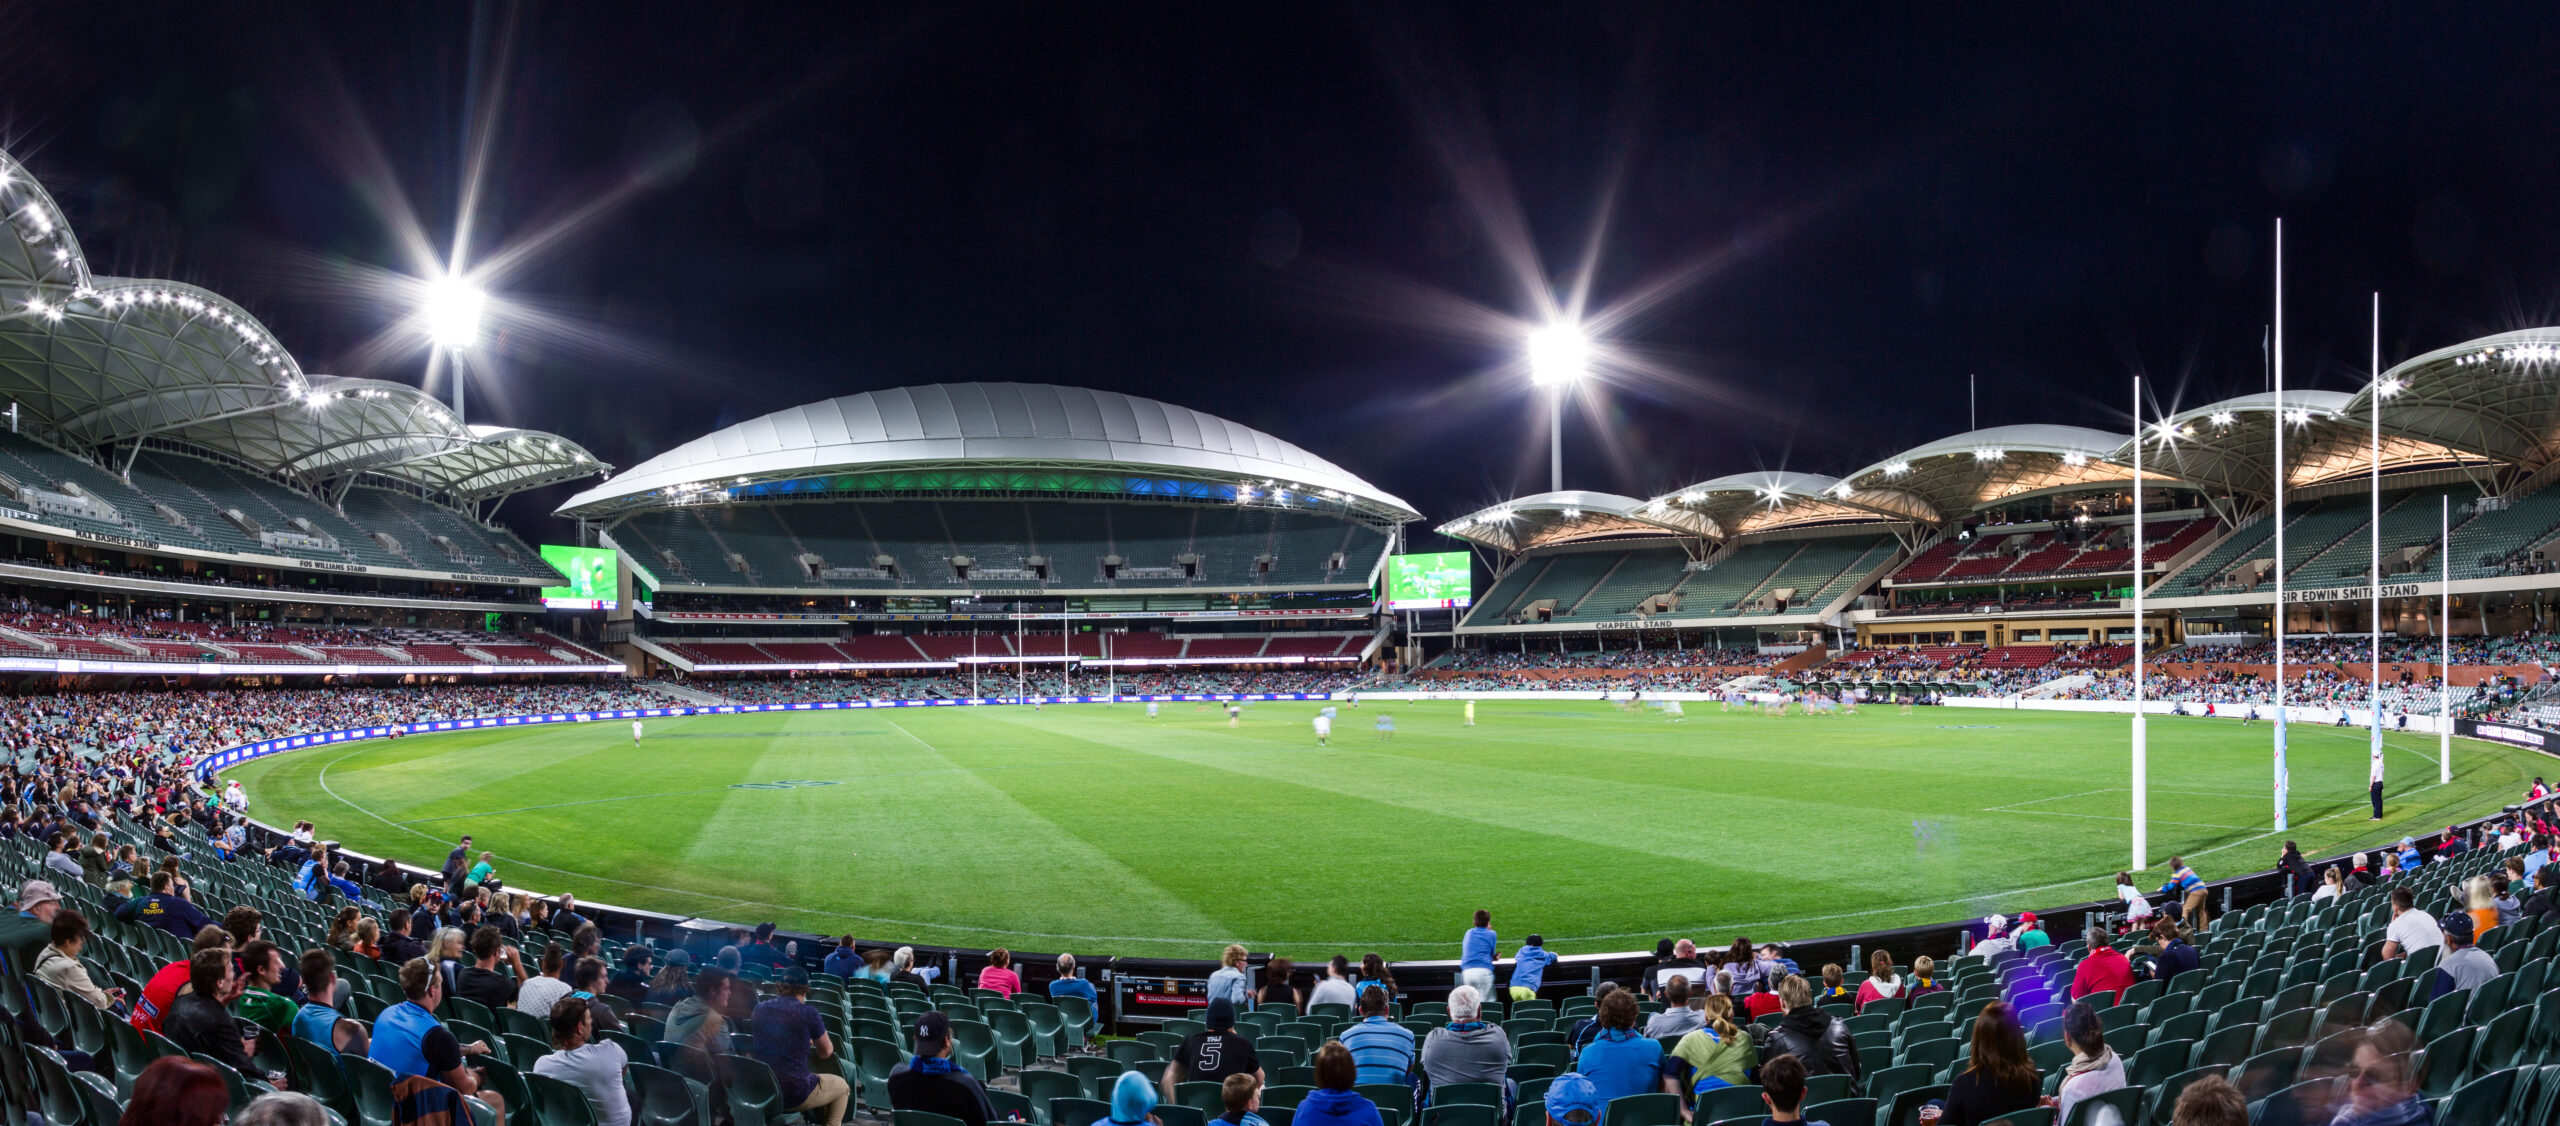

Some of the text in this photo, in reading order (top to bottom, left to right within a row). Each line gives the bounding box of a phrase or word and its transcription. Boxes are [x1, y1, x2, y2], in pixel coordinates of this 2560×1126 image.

[76, 529, 159, 550] MAX BASHEER STAND
[315, 562, 344, 570] WILLIAMS
[2282, 584, 2419, 601] SIR EDWIN SMITH STAND
[1596, 620, 1672, 630] CHAPPELL STAND
[1199, 1042, 1222, 1070] 5
